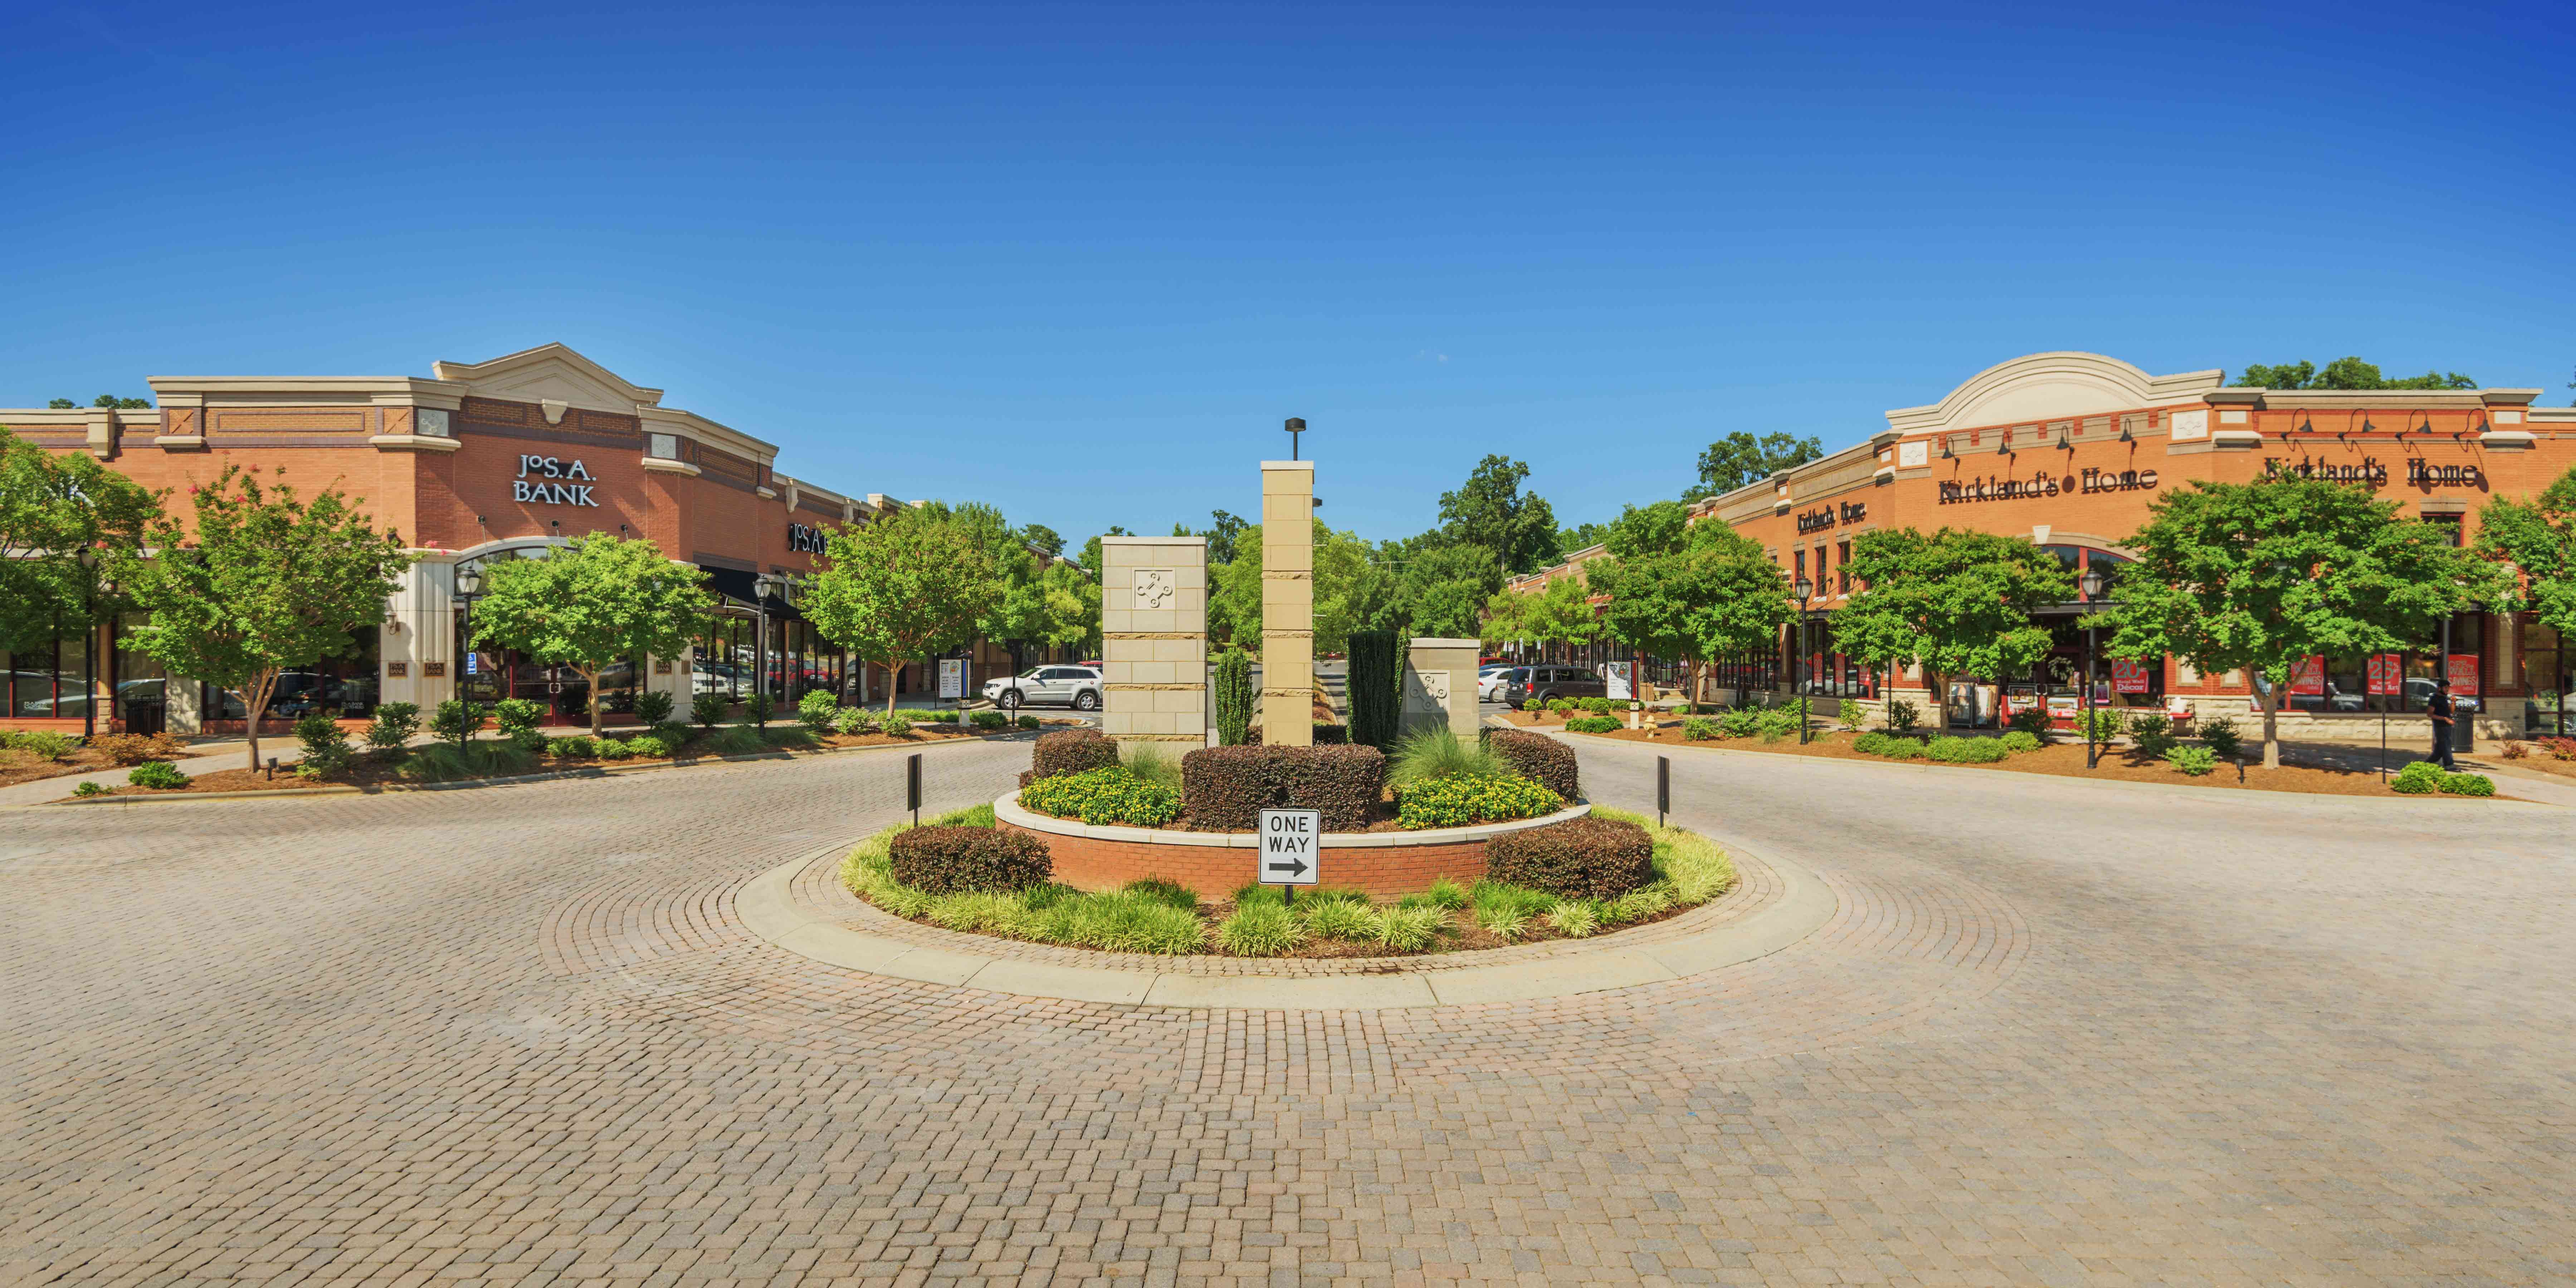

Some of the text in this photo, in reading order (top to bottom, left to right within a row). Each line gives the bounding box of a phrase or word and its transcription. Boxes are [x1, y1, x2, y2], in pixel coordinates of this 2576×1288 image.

[566, 459, 597, 481] A.
[2264, 455, 2477, 484] Kirkland's Home
[512, 480, 600, 507] BANK
[1938, 467, 2157, 503] Kirkland's Home
[1797, 501, 1867, 532] Kirkland's Home
[811, 529, 823, 554] A.
[2114, 661, 2140, 679] 20
[2297, 675, 2321, 685] AVINGS
[1271, 816, 1308, 832] ONE
[1269, 836, 1310, 853] WAY
